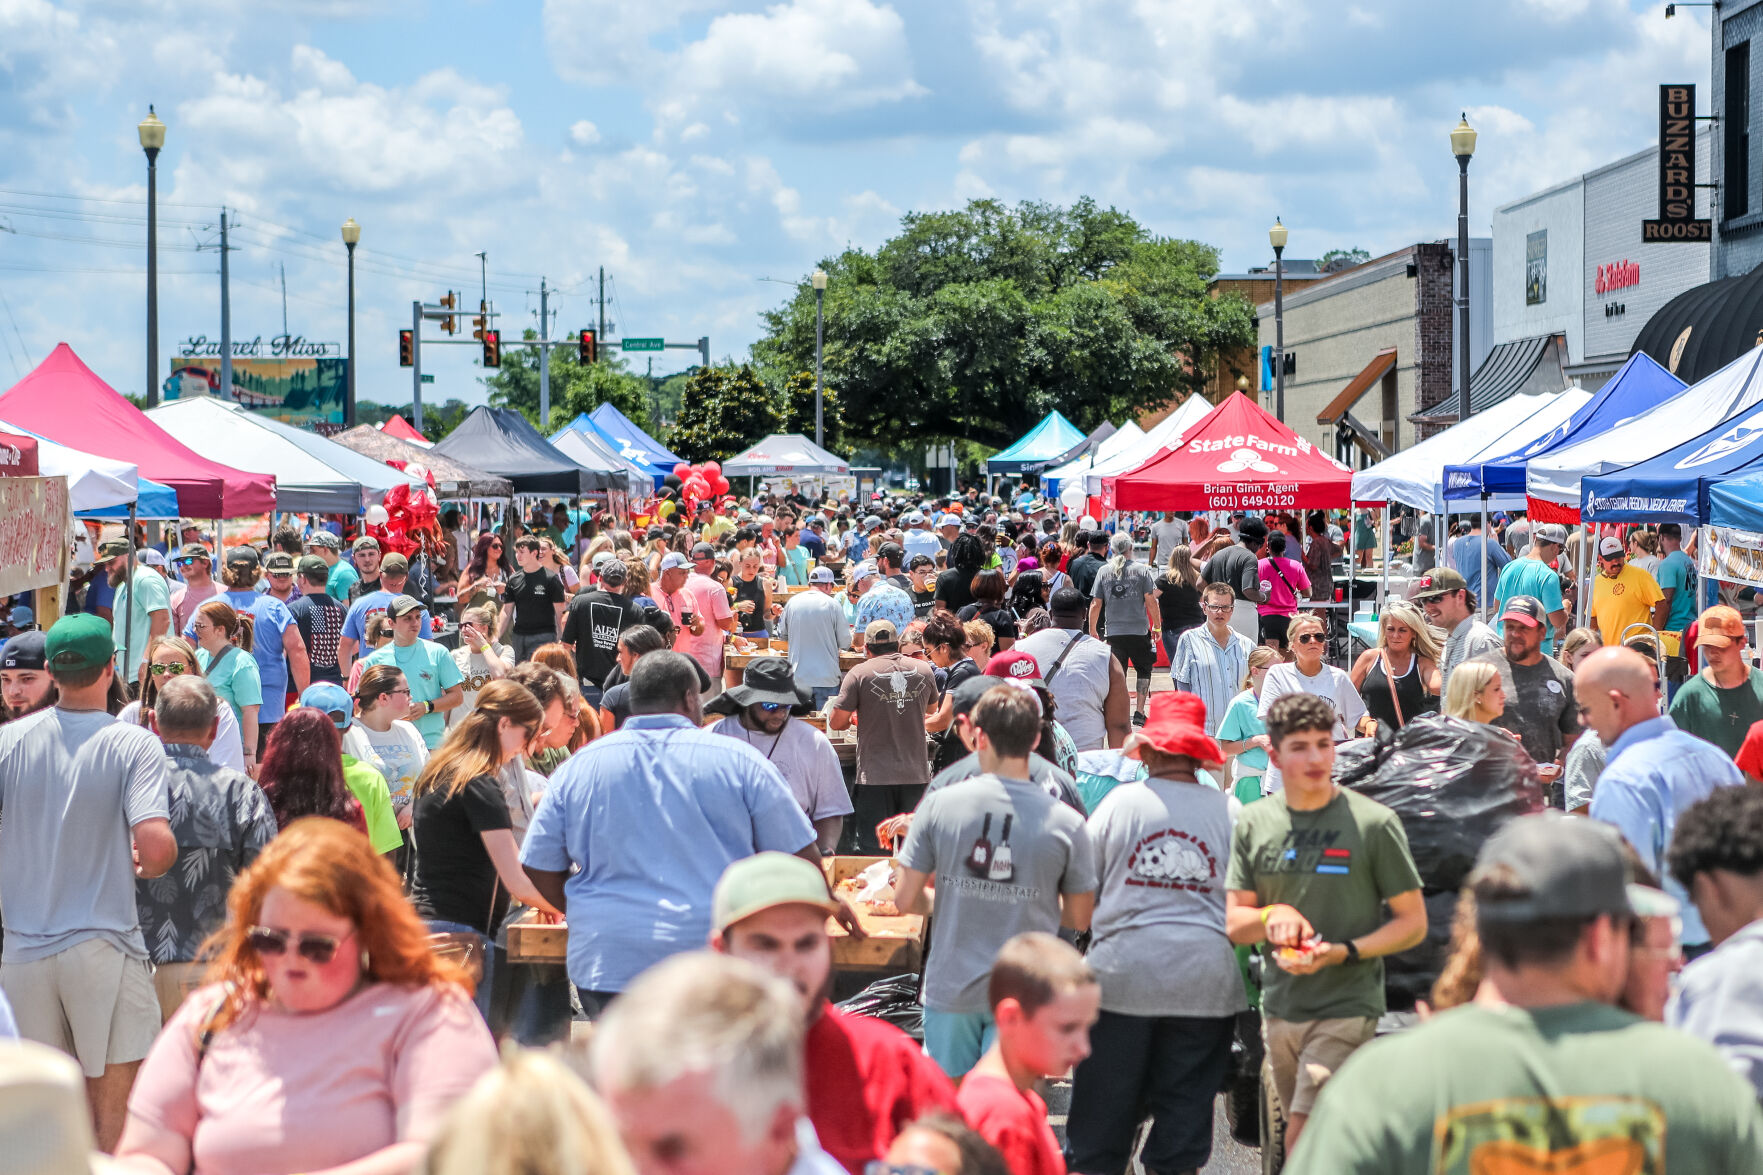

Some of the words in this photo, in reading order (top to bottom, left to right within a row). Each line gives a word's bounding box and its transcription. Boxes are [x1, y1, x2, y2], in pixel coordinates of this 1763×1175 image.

[1665, 88, 1692, 218] BUZZARD'S
[1645, 222, 1711, 239] ROOST
[182, 335, 262, 356] Larel
[271, 335, 329, 356] Miss
[625, 341, 647, 349] Central
[649, 341, 661, 349] Ave
[1188, 435, 1245, 453] State
[1246, 434, 1298, 456] Farm
[1203, 483, 1233, 494] Brian
[1236, 483, 1265, 494] Ginn,
[1267, 482, 1299, 495] Agent
[1208, 496, 1238, 508] (601)
[1241, 494, 1295, 507] 649-0120
[1595, 497, 1610, 510] SOUTH
[1611, 497, 1628, 510] CENTRAL
[1629, 497, 1650, 511] REGIONAL
[1666, 499, 1687, 513] CENTER
[594, 624, 617, 636] ALFA
[880, 690, 920, 701] ARIAT
[1006, 884, 1041, 898] STATE
